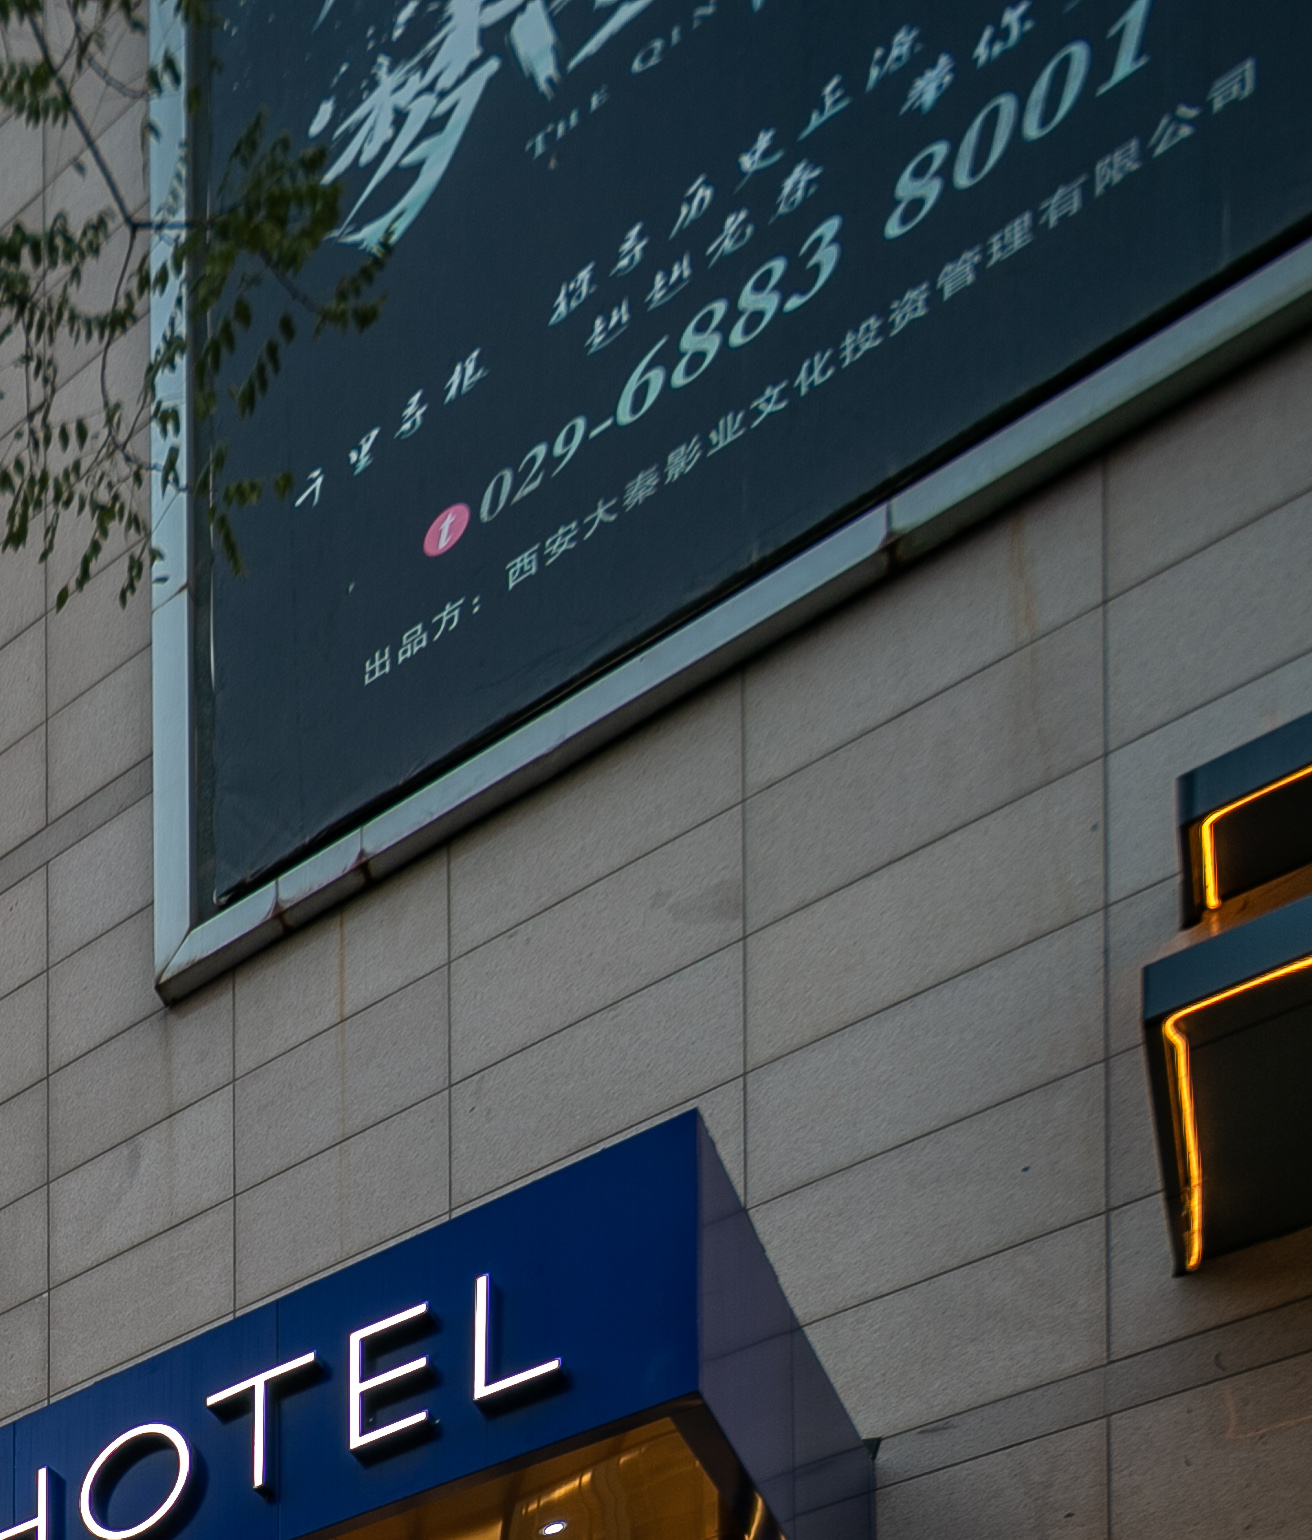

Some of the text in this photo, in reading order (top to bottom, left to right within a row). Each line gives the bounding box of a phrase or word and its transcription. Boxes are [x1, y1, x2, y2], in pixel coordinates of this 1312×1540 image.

[899, 0, 1076, 117] 带你
[480, 215, 843, 523] 029-6883
[883, 0, 1152, 241] 8001
